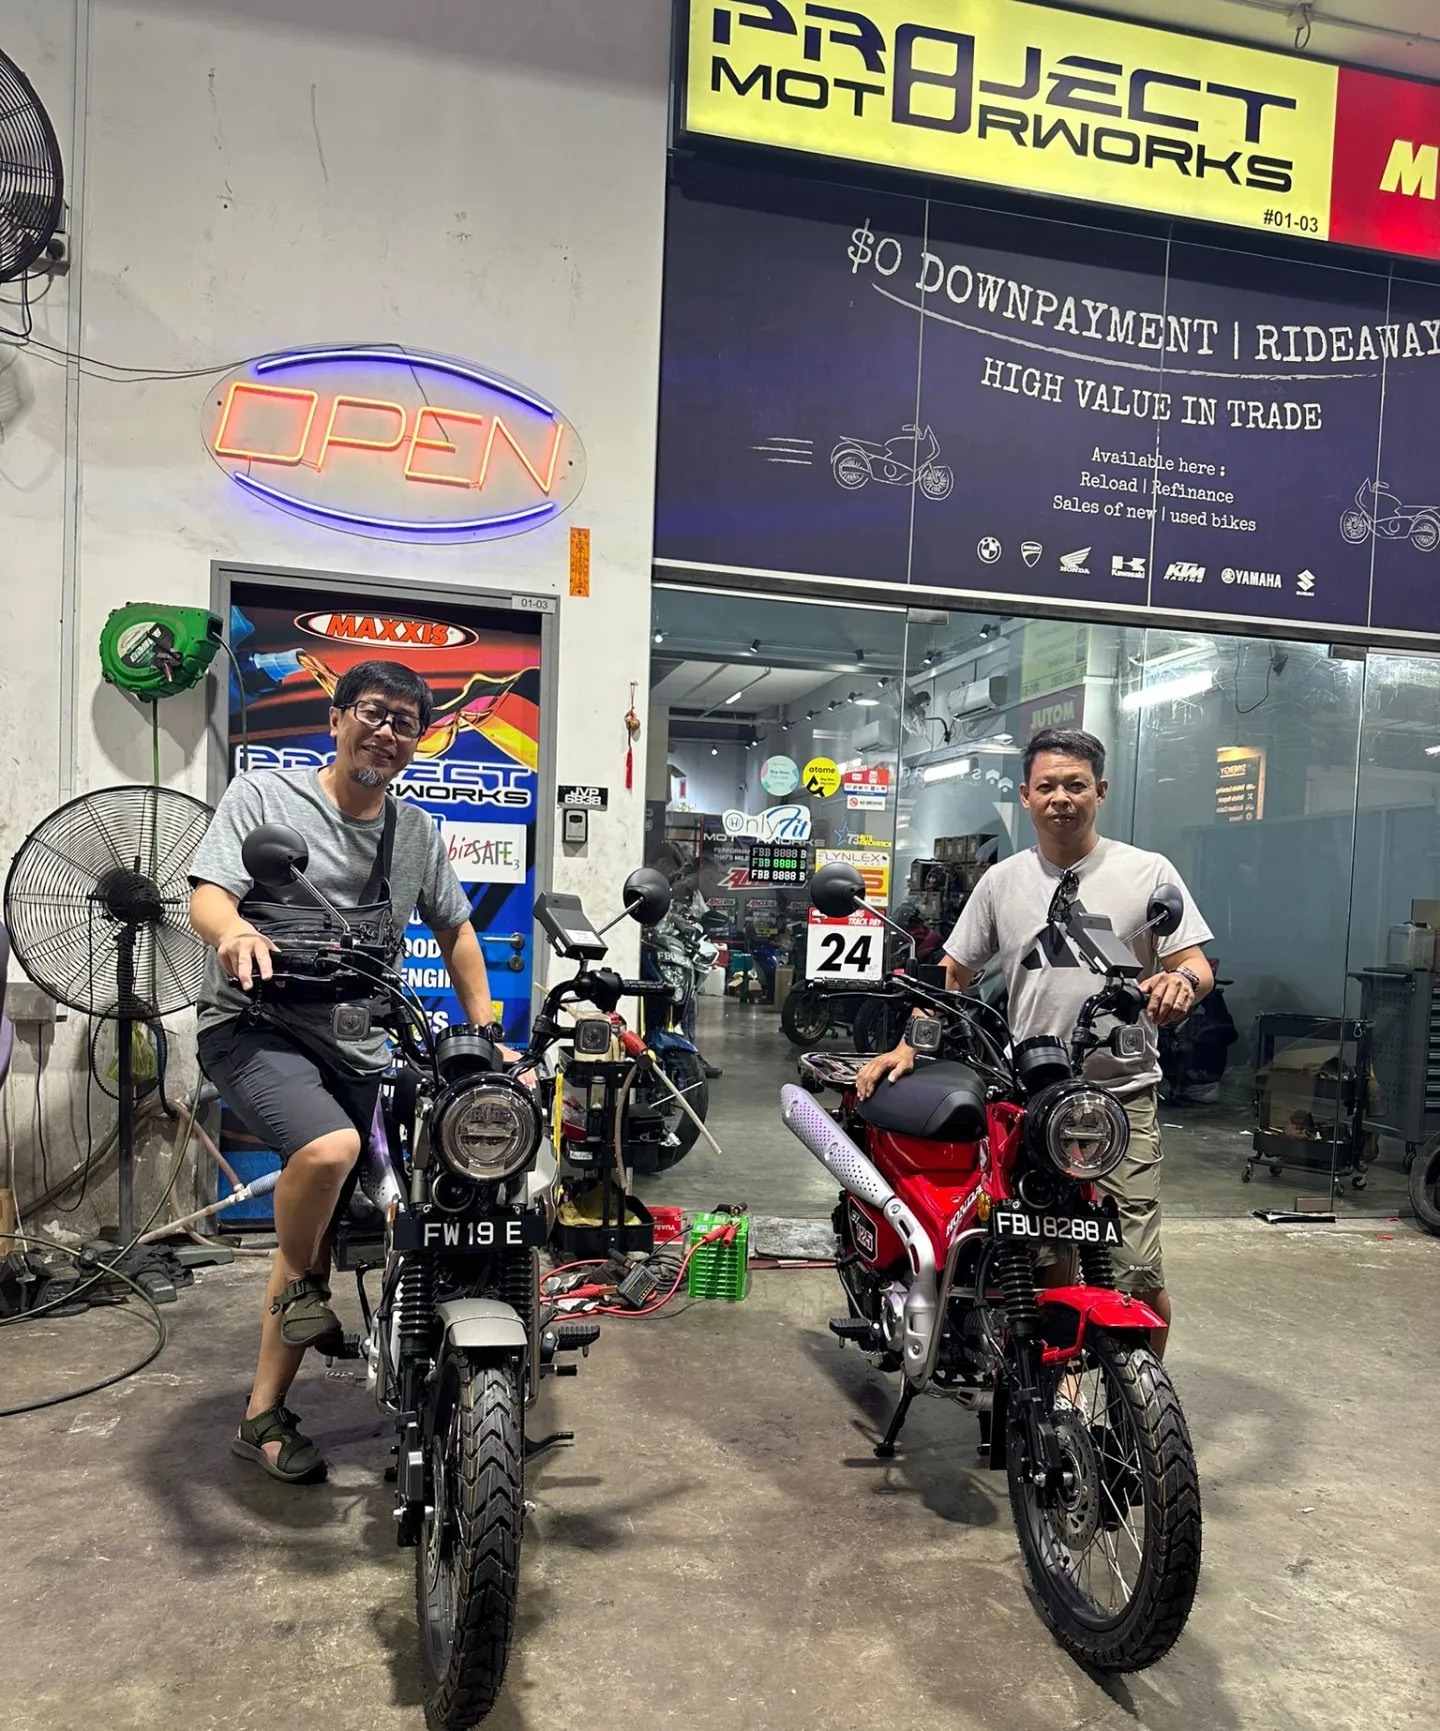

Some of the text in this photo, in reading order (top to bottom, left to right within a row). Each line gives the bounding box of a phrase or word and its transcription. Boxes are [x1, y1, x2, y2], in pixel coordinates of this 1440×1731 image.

[1264, 209, 1318, 232] #01-03
[848, 218, 902, 276] $0
[916, 252, 1218, 355] DOWNPAYMENT
[1254, 319, 1440, 362] RIDEAWAY
[981, 357, 1322, 431] HIGH VALUE IN TRADE
[214, 381, 563, 495] OPEN
[1091, 447, 1174, 471] Available
[1080, 472, 1138, 493] Reload
[1151, 480, 1234, 504] Refinance
[1053, 495, 1099, 514] Sales
[1104, 501, 1123, 517] of
[1127, 506, 1157, 521] new
[1170, 510, 1207, 527] used
[1211, 513, 1257, 532] bikes
[1060, 566, 1090, 575] HONDA
[1111, 568, 1146, 579] Kawasaki
[1166, 561, 1206, 580] KTM
[1235, 569, 1282, 589] YAMAHA
[521, 598, 549, 610] 01-03
[326, 613, 449, 646] MAXXIS
[808, 766, 836, 774] atome
[564, 794, 601, 805] 6838
[570, 787, 599, 797] JVP
[752, 847, 807, 859] FBB 8888 B
[752, 857, 806, 869] FBB 8888 B
[751, 869, 806, 881] FBB 8888 B
[816, 933, 872, 973] 24
[946, 1184, 983, 1238] HONDA
[423, 1221, 523, 1247] FW 19 E
[996, 1212, 1119, 1244] FBU 8288 A
